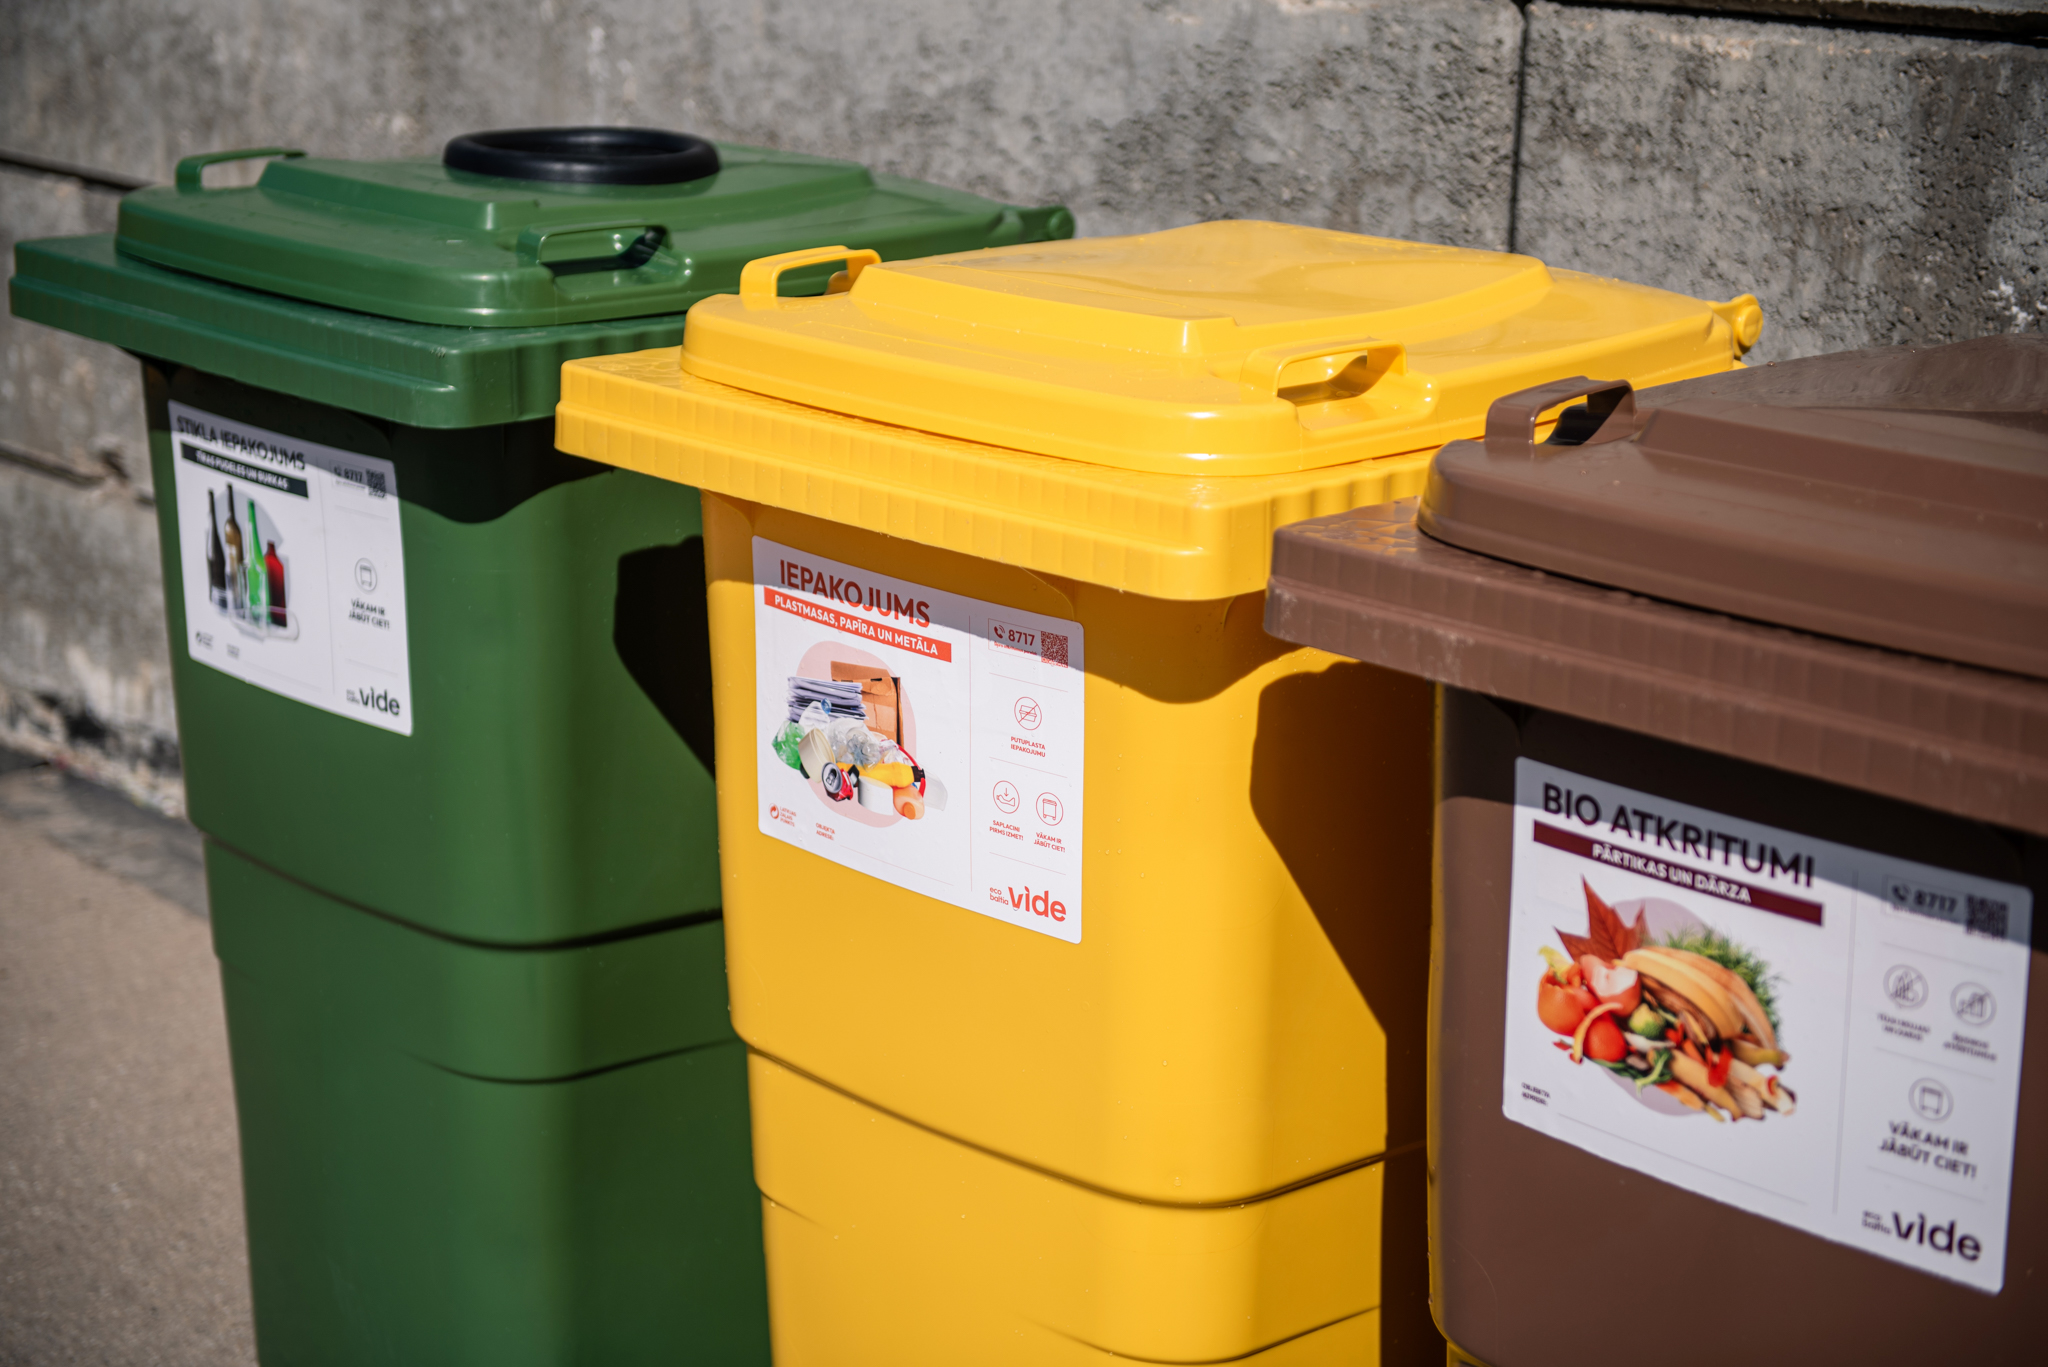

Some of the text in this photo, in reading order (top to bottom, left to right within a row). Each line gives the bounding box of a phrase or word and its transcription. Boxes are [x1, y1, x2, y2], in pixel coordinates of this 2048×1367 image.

[176, 415, 306, 470] STIKLA IEPAKOJUMS
[780, 559, 931, 628] IEPAKOJUMS
[774, 594, 938, 656] PLASTMASAS, PAPĪRA UN METĀLA
[1008, 629, 1036, 647] 8717
[1010, 736, 1046, 751] PUTUPLASTA
[1010, 744, 1046, 758] IEPAKOJUMU
[989, 826, 1024, 841] PIRMS IZMET!
[992, 819, 1020, 833] SAPLACINI
[1035, 832, 1056, 843] VĀKAM
[1543, 782, 1815, 888] BIO ATKRITUMI
[1033, 838, 1066, 853] JĀBŪT CIET!
[1592, 843, 1752, 904] PĀRTIKAS UN DĀRZA
[989, 886, 1002, 896] eco
[989, 893, 1009, 906] baltia
[1888, 1120, 1950, 1151] VĀKAM
[1933, 1154, 1978, 1180] CIET!
